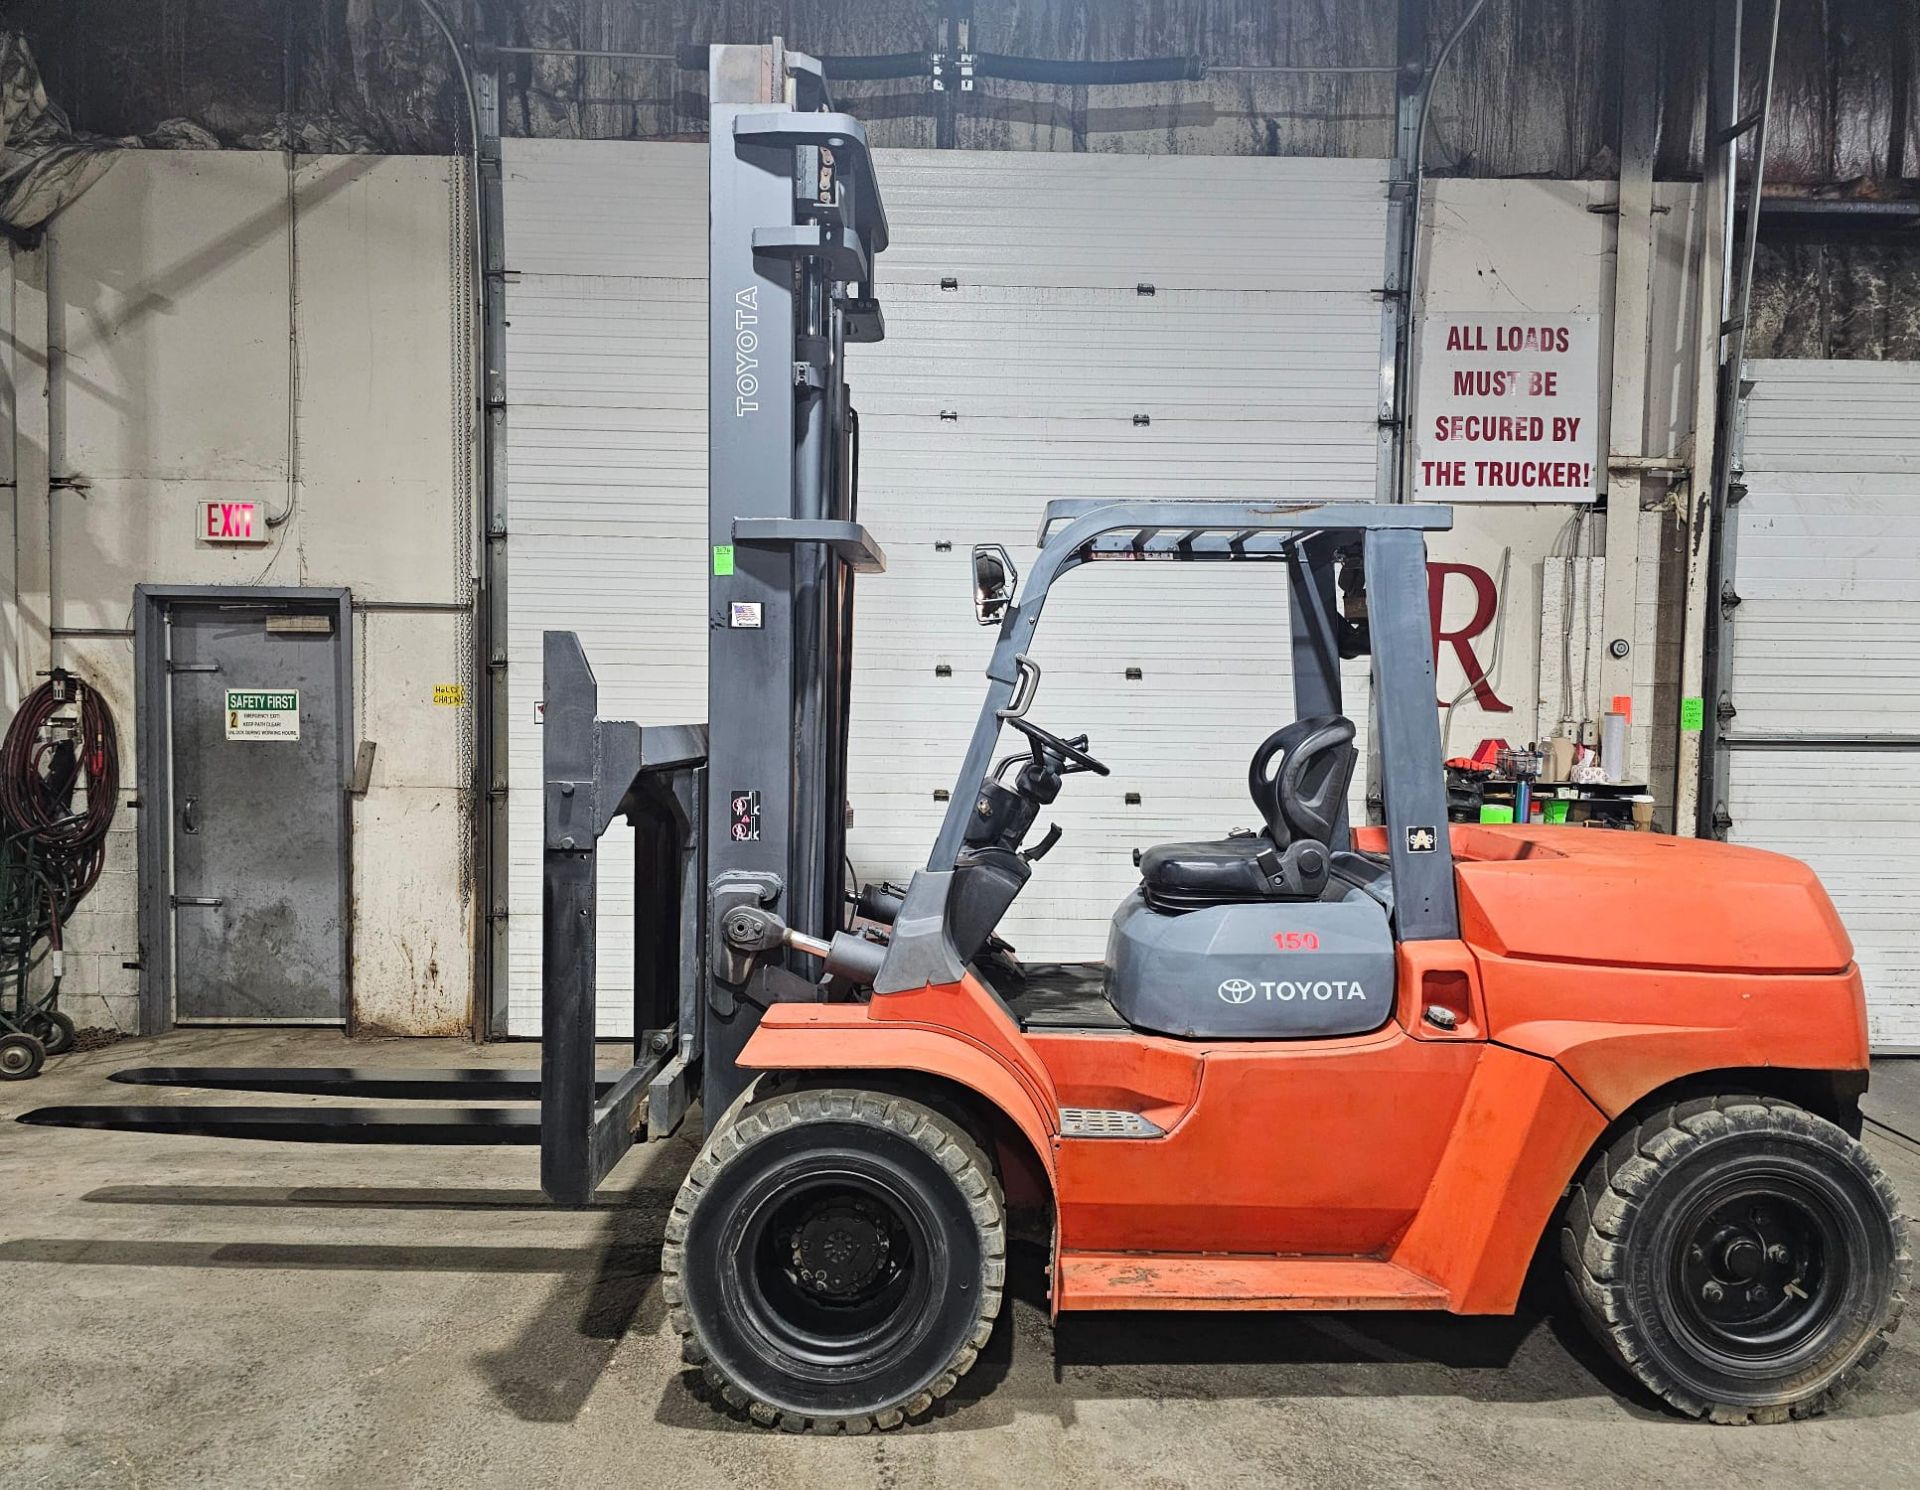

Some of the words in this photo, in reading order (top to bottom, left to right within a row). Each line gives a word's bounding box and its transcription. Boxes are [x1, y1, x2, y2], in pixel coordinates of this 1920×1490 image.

[735, 285, 759, 417] TOYOTA
[1446, 325, 1488, 351] ALL
[1496, 325, 1570, 353] LOADS
[1453, 370, 1521, 397] MUST
[1528, 371, 1558, 397] BE
[1435, 415, 1544, 442] SECURED
[1552, 417, 1582, 442] BY
[1421, 461, 1467, 487] THE
[1474, 461, 1590, 488] TRUCKER!
[207, 503, 254, 537] EXIT
[229, 694, 265, 709] SAFETY
[267, 695, 295, 709] FIRST
[230, 711, 238, 729] 2
[1272, 931, 1320, 950] 150
[1260, 981, 1367, 1000] TOYOTA
